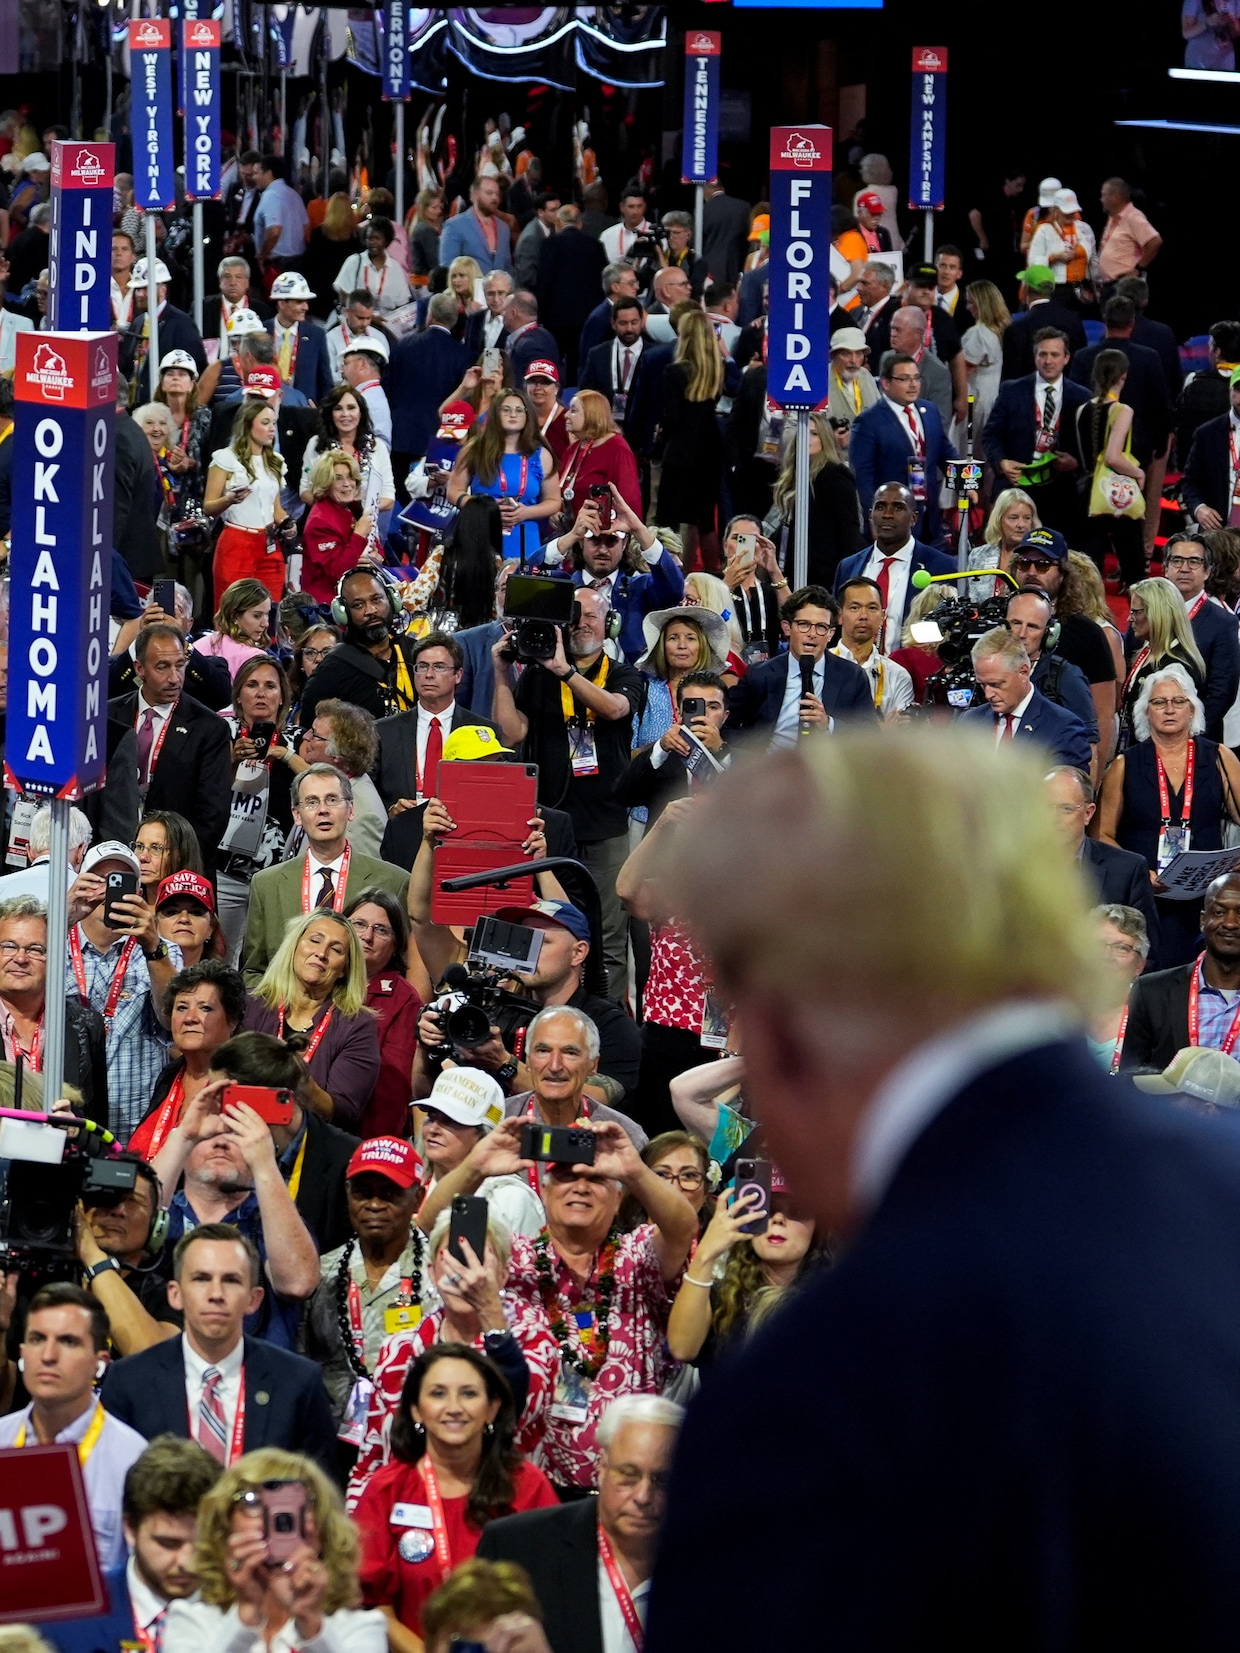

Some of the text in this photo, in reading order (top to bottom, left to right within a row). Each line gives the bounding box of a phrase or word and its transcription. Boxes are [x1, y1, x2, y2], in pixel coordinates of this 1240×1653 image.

[142, 53, 158, 101] WEST
[193, 51, 213, 106] NEW
[921, 74, 936, 106] NEW
[693, 57, 709, 176] TENNESSEE
[146, 106, 161, 201] VIRGINIA
[194, 116, 212, 191] YORK
[921, 111, 935, 202] HAMPSHIRE
[75, 198, 98, 331] INDI
[783, 179, 814, 392] FLORIDA
[26, 372, 74, 388] MILWAUKEE
[25, 418, 64, 765] OKLAHOMA
[85, 418, 108, 764] OKLAHOMA
[165, 882, 207, 895] AMERICA
[173, 873, 197, 884] SAVE
[1172, 866, 1198, 886] MAKE
[1183, 858, 1220, 892] AMERICA
[361, 1151, 404, 1164] TRUMP
[362, 1139, 409, 1155] HAWAII
